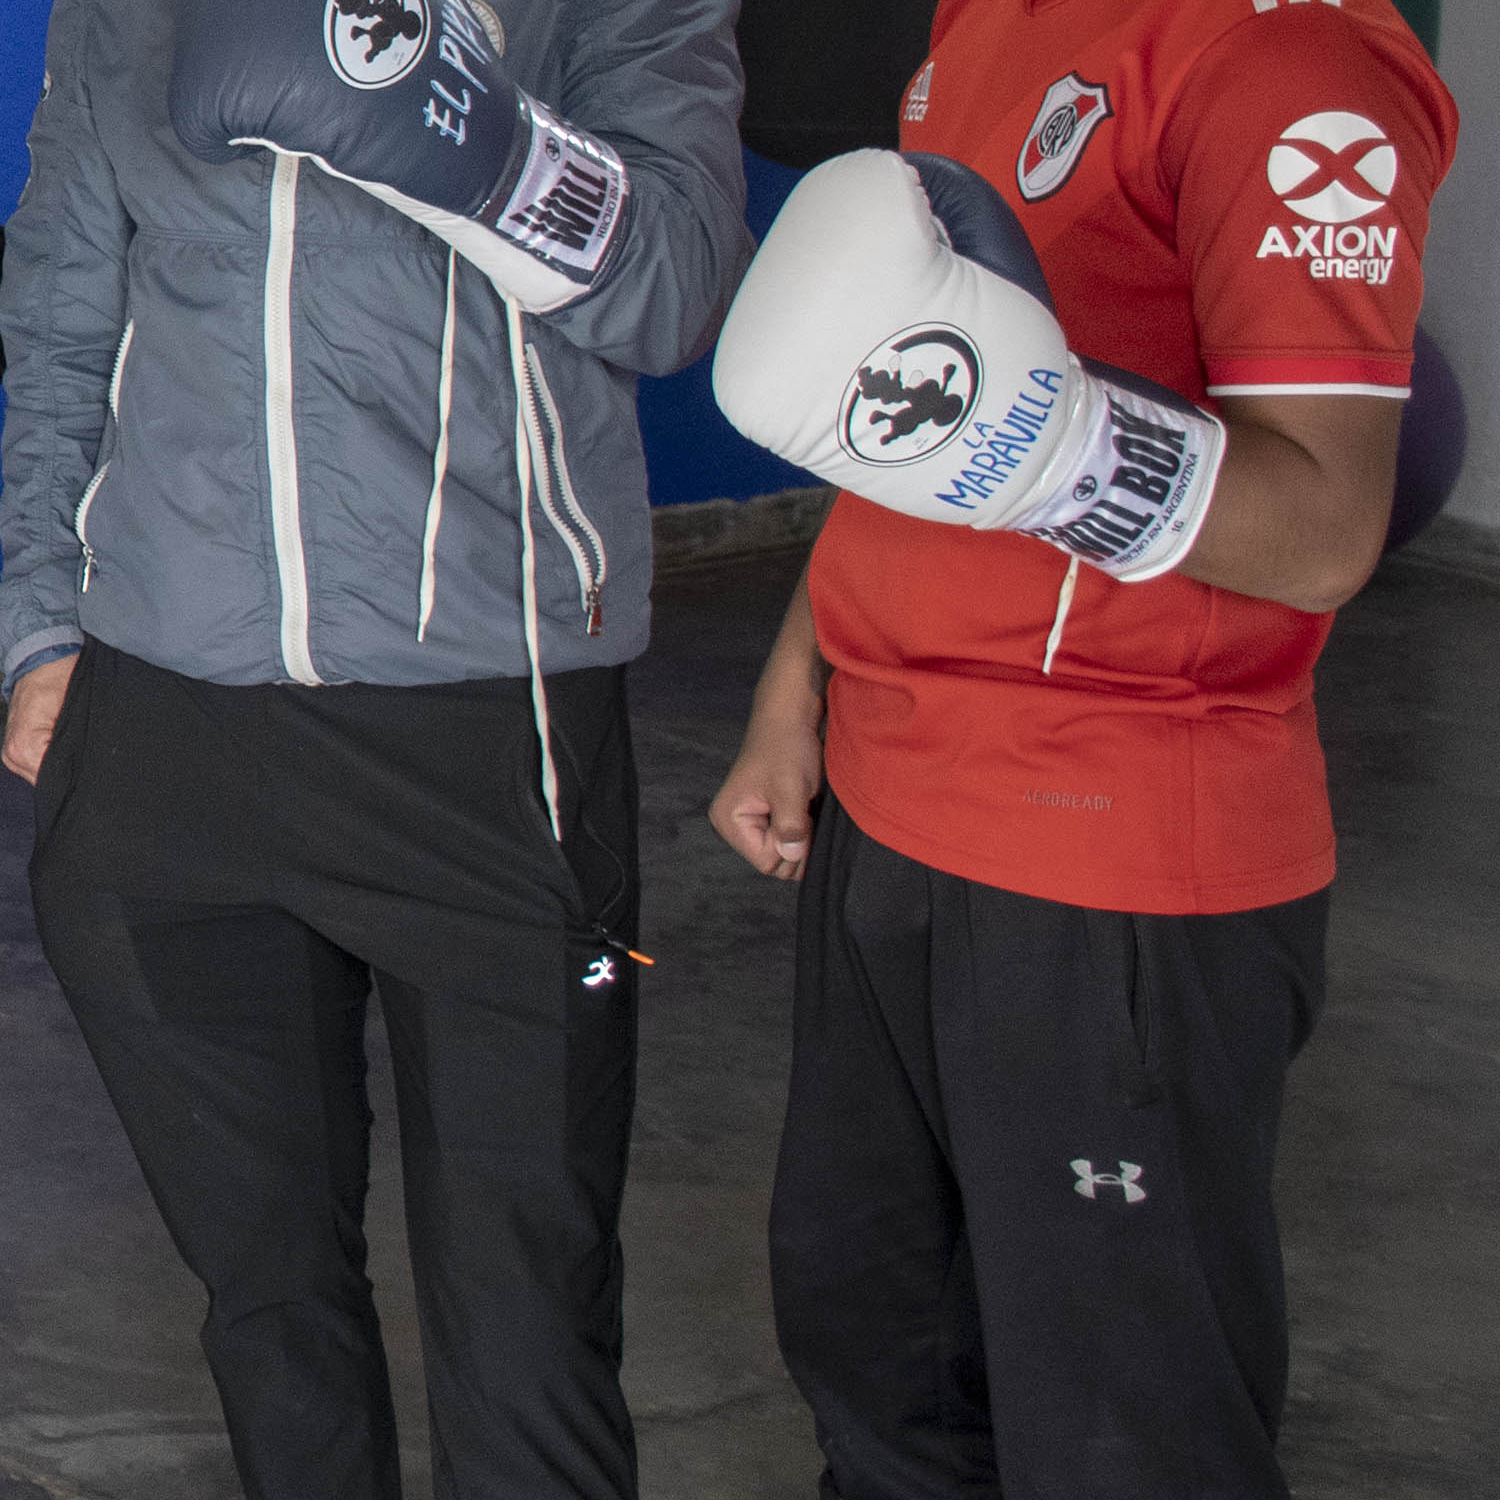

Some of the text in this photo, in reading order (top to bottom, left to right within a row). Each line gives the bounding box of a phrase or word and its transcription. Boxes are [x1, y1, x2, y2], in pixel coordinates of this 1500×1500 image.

[422, 79, 472, 146] EL
[1255, 225, 1398, 259] AXION
[1309, 257, 1394, 285] energy
[934, 368, 1064, 510] MARAVILLA
[962, 421, 995, 449] LA
[1103, 389, 1186, 507] BOX
[1161, 452, 1200, 525] ARGENTINA
